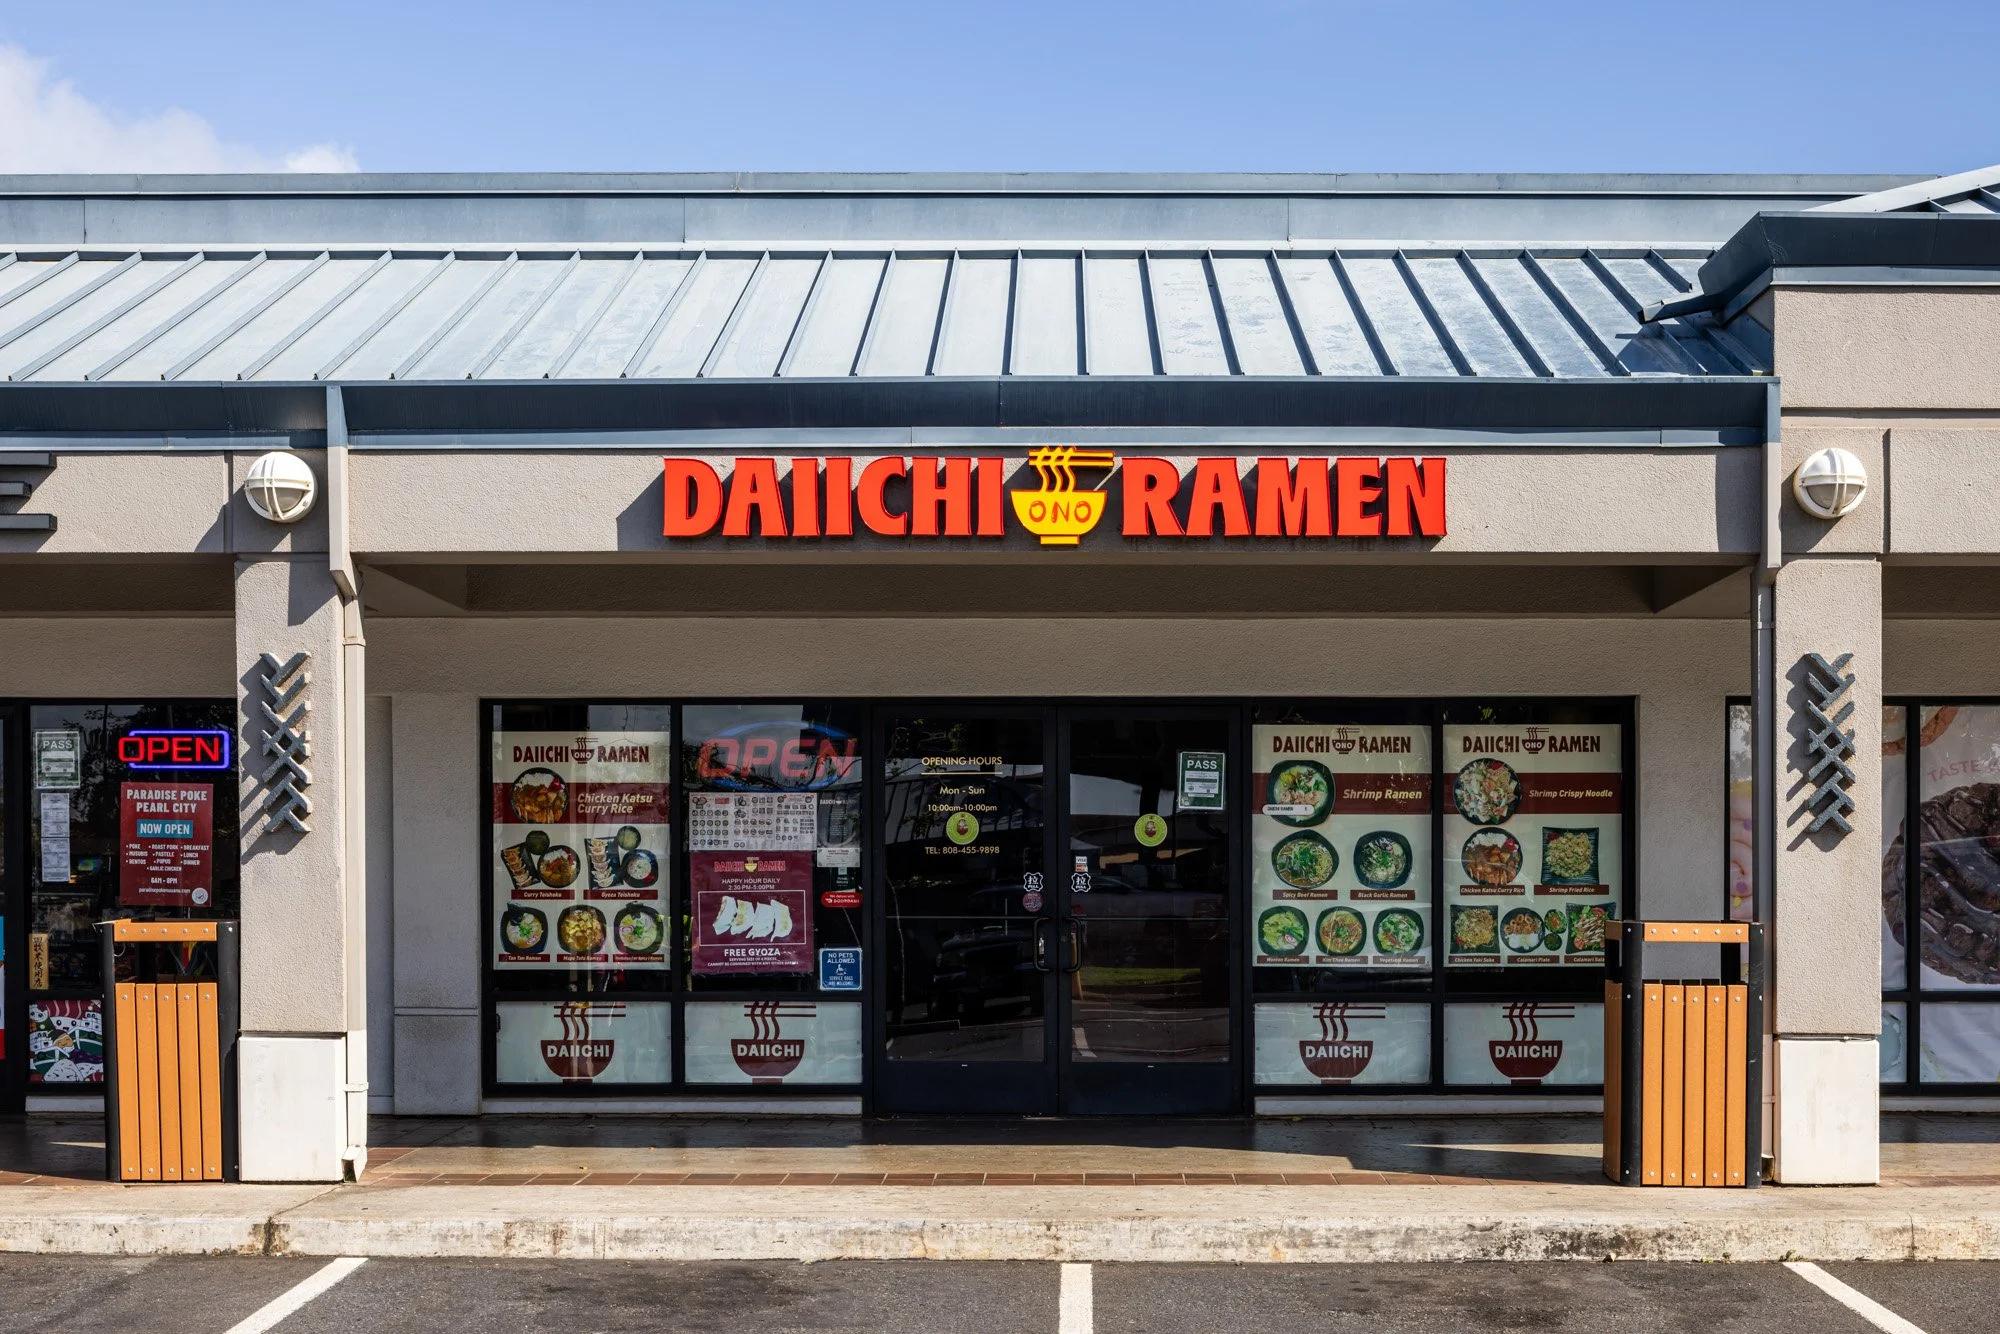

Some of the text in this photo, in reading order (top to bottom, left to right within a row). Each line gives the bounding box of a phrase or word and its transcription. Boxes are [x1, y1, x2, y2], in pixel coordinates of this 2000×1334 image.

[663, 456, 1447, 537] DAIICHI ONO RAMEN
[42, 740, 73, 749] PASS
[118, 737, 220, 762] OPEN
[1272, 736, 1330, 753] DAIICHI
[1358, 736, 1412, 753] RAMEN
[1462, 736, 1520, 753] DAIICHI
[1548, 735, 1601, 753] RAMEN
[513, 745, 569, 763] DAIICHI
[597, 745, 650, 763] RAMEN
[697, 738, 857, 778] OPEN
[921, 756, 1003, 766] OPENING HOURS
[1187, 760, 1218, 770] PASS
[1926, 759, 1982, 782] TASTE
[126, 789, 208, 801] PARADISE POKE
[939, 786, 960, 795] Mon
[968, 786, 985, 795] Sun
[1342, 789, 1422, 801] Shrimp Ramen
[1529, 789, 1613, 799] Shrimp Crispy Noodle
[577, 793, 653, 803] Chicken Katsu
[136, 802, 197, 814] PEARL CITY
[577, 803, 633, 815] Curry Rice
[927, 804, 998, 813] 10:00am-10:00pm
[140, 823, 190, 835] NOW OPEN
[925, 846, 1000, 855] TEL: 808-455-9898
[724, 947, 781, 957] FREE GYOZA
[547, 1044, 610, 1058] DAIICHI
[737, 1044, 800, 1057] DAIICHI
[1305, 1045, 1369, 1059] DAIICHI
[1495, 1045, 1558, 1059] DAIICHI
